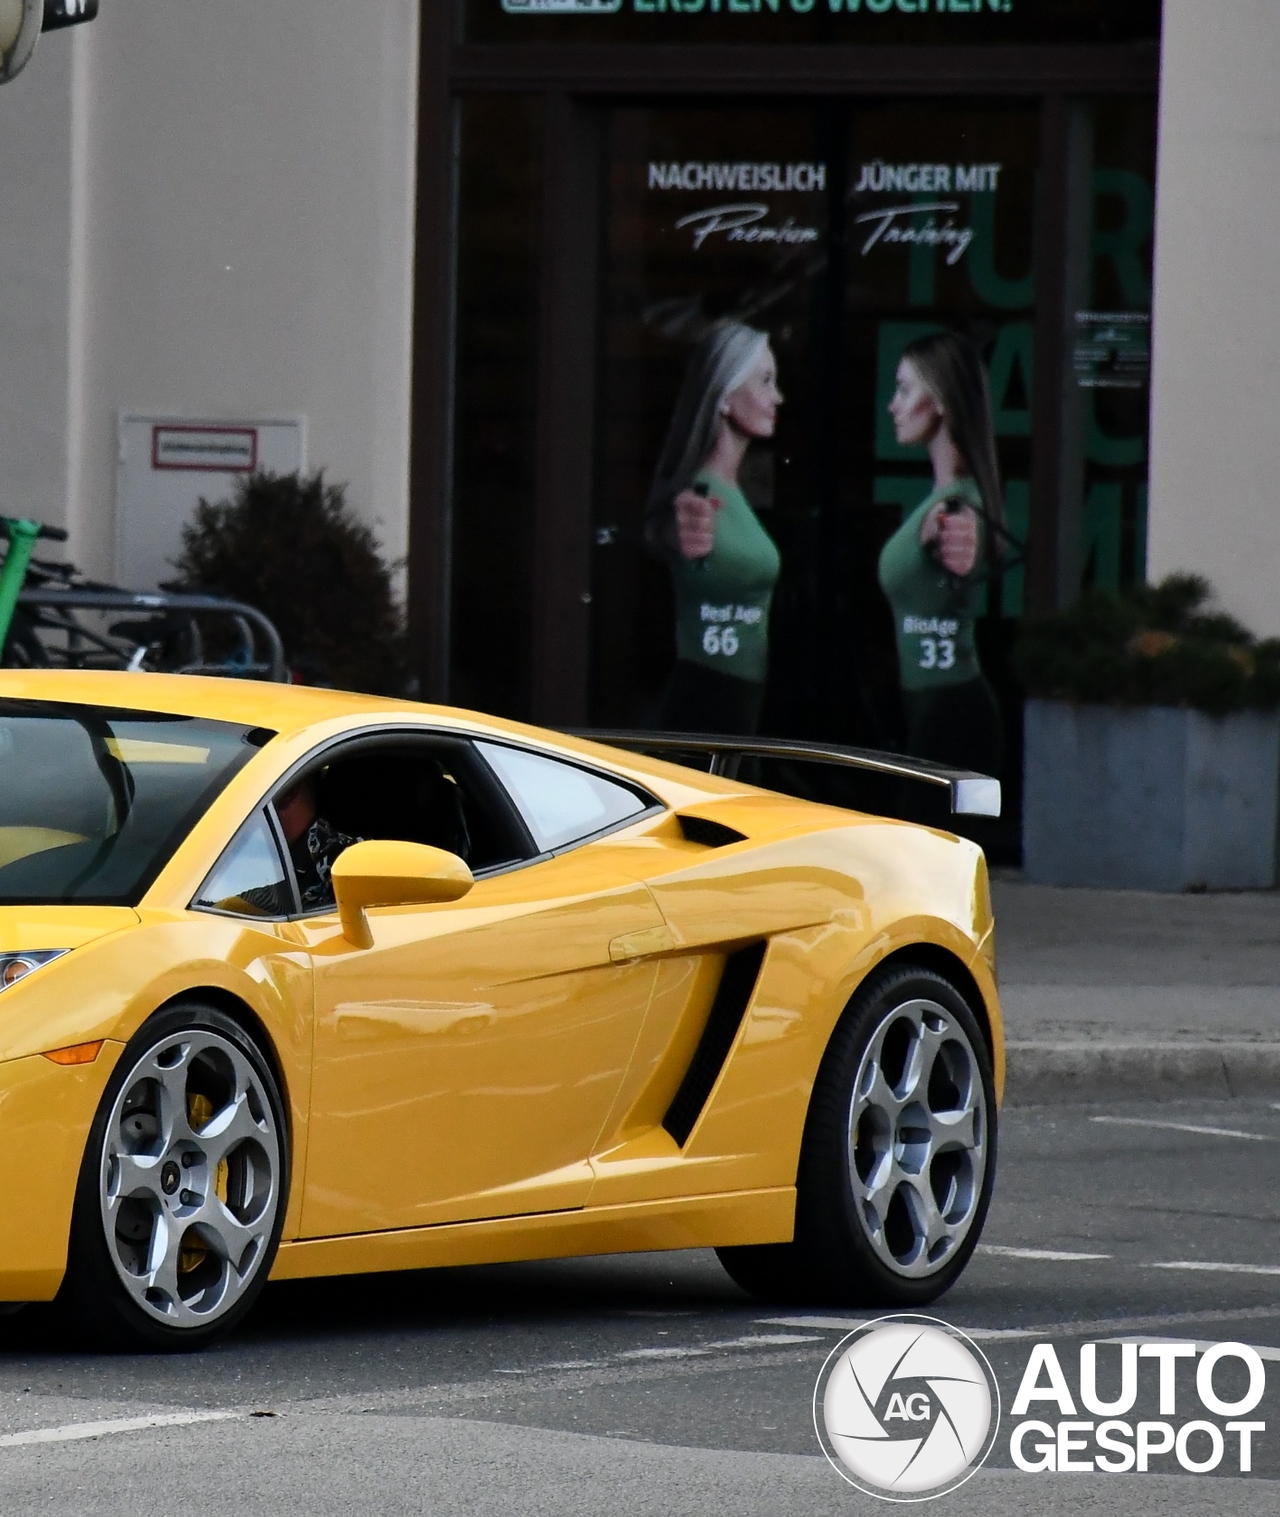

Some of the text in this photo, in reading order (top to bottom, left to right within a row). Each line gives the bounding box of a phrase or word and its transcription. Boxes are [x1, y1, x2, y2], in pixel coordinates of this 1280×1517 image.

[647, 161, 827, 192] NACHWEISLICH
[854, 158, 1002, 193] JÜNGER MIT
[674, 202, 819, 252] Premium
[854, 201, 974, 266] Training
[702, 625, 740, 656] 66
[919, 638, 956, 670] 33
